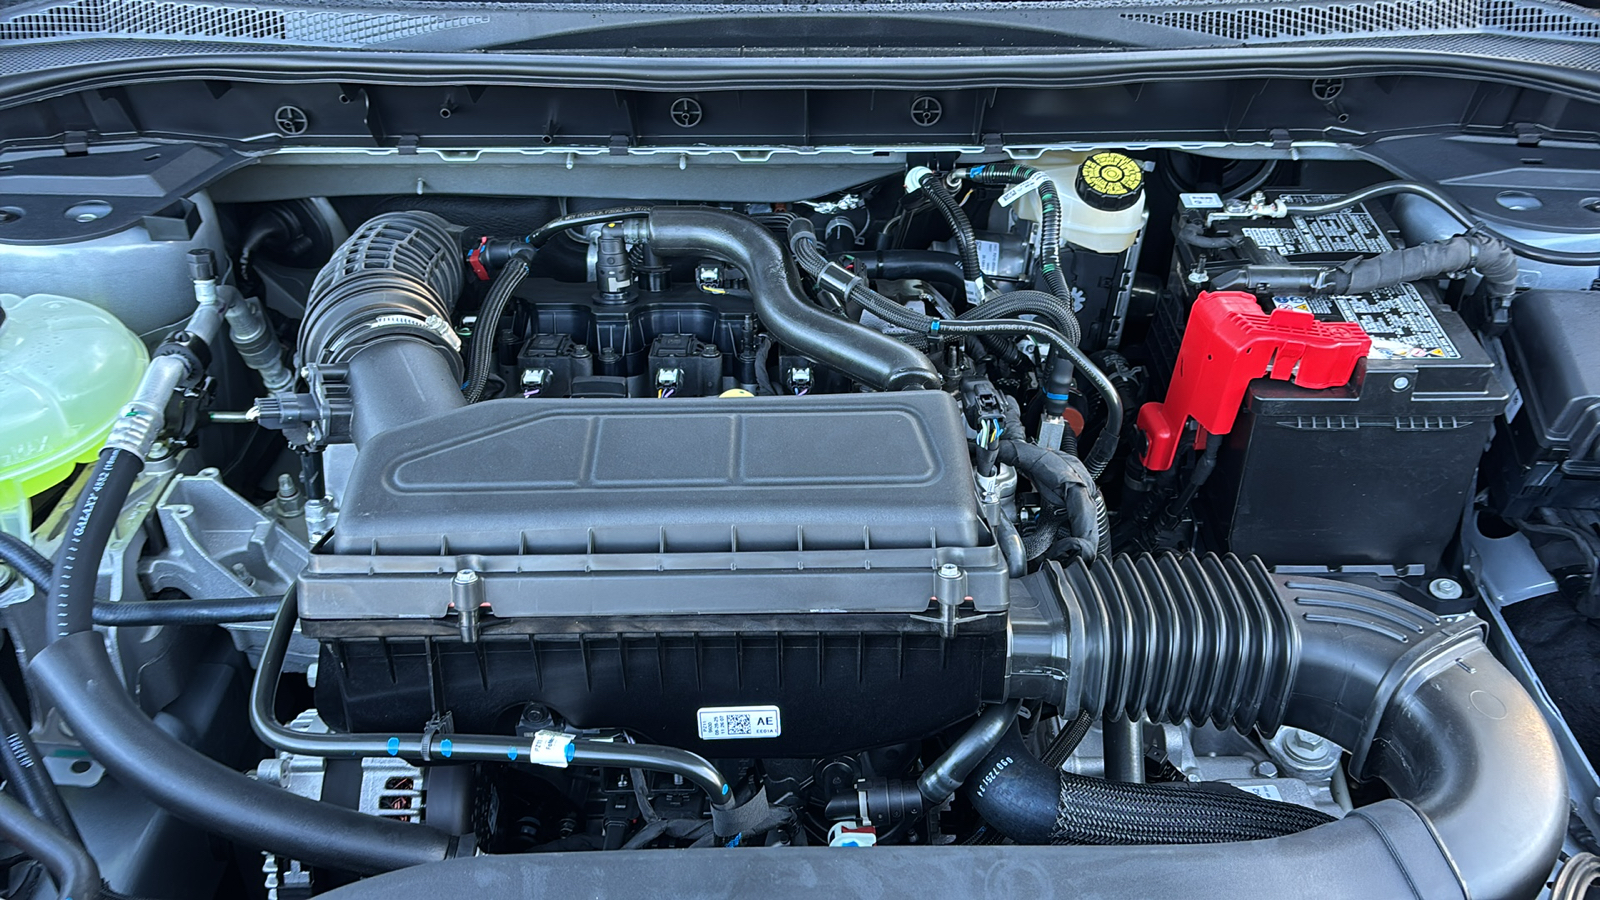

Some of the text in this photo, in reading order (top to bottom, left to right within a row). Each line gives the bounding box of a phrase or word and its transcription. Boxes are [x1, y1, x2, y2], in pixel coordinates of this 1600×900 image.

[948, 324, 984, 332] AUTOMOTIVE
[73, 493, 99, 536] GALAXY
[757, 716, 774, 726] AE
